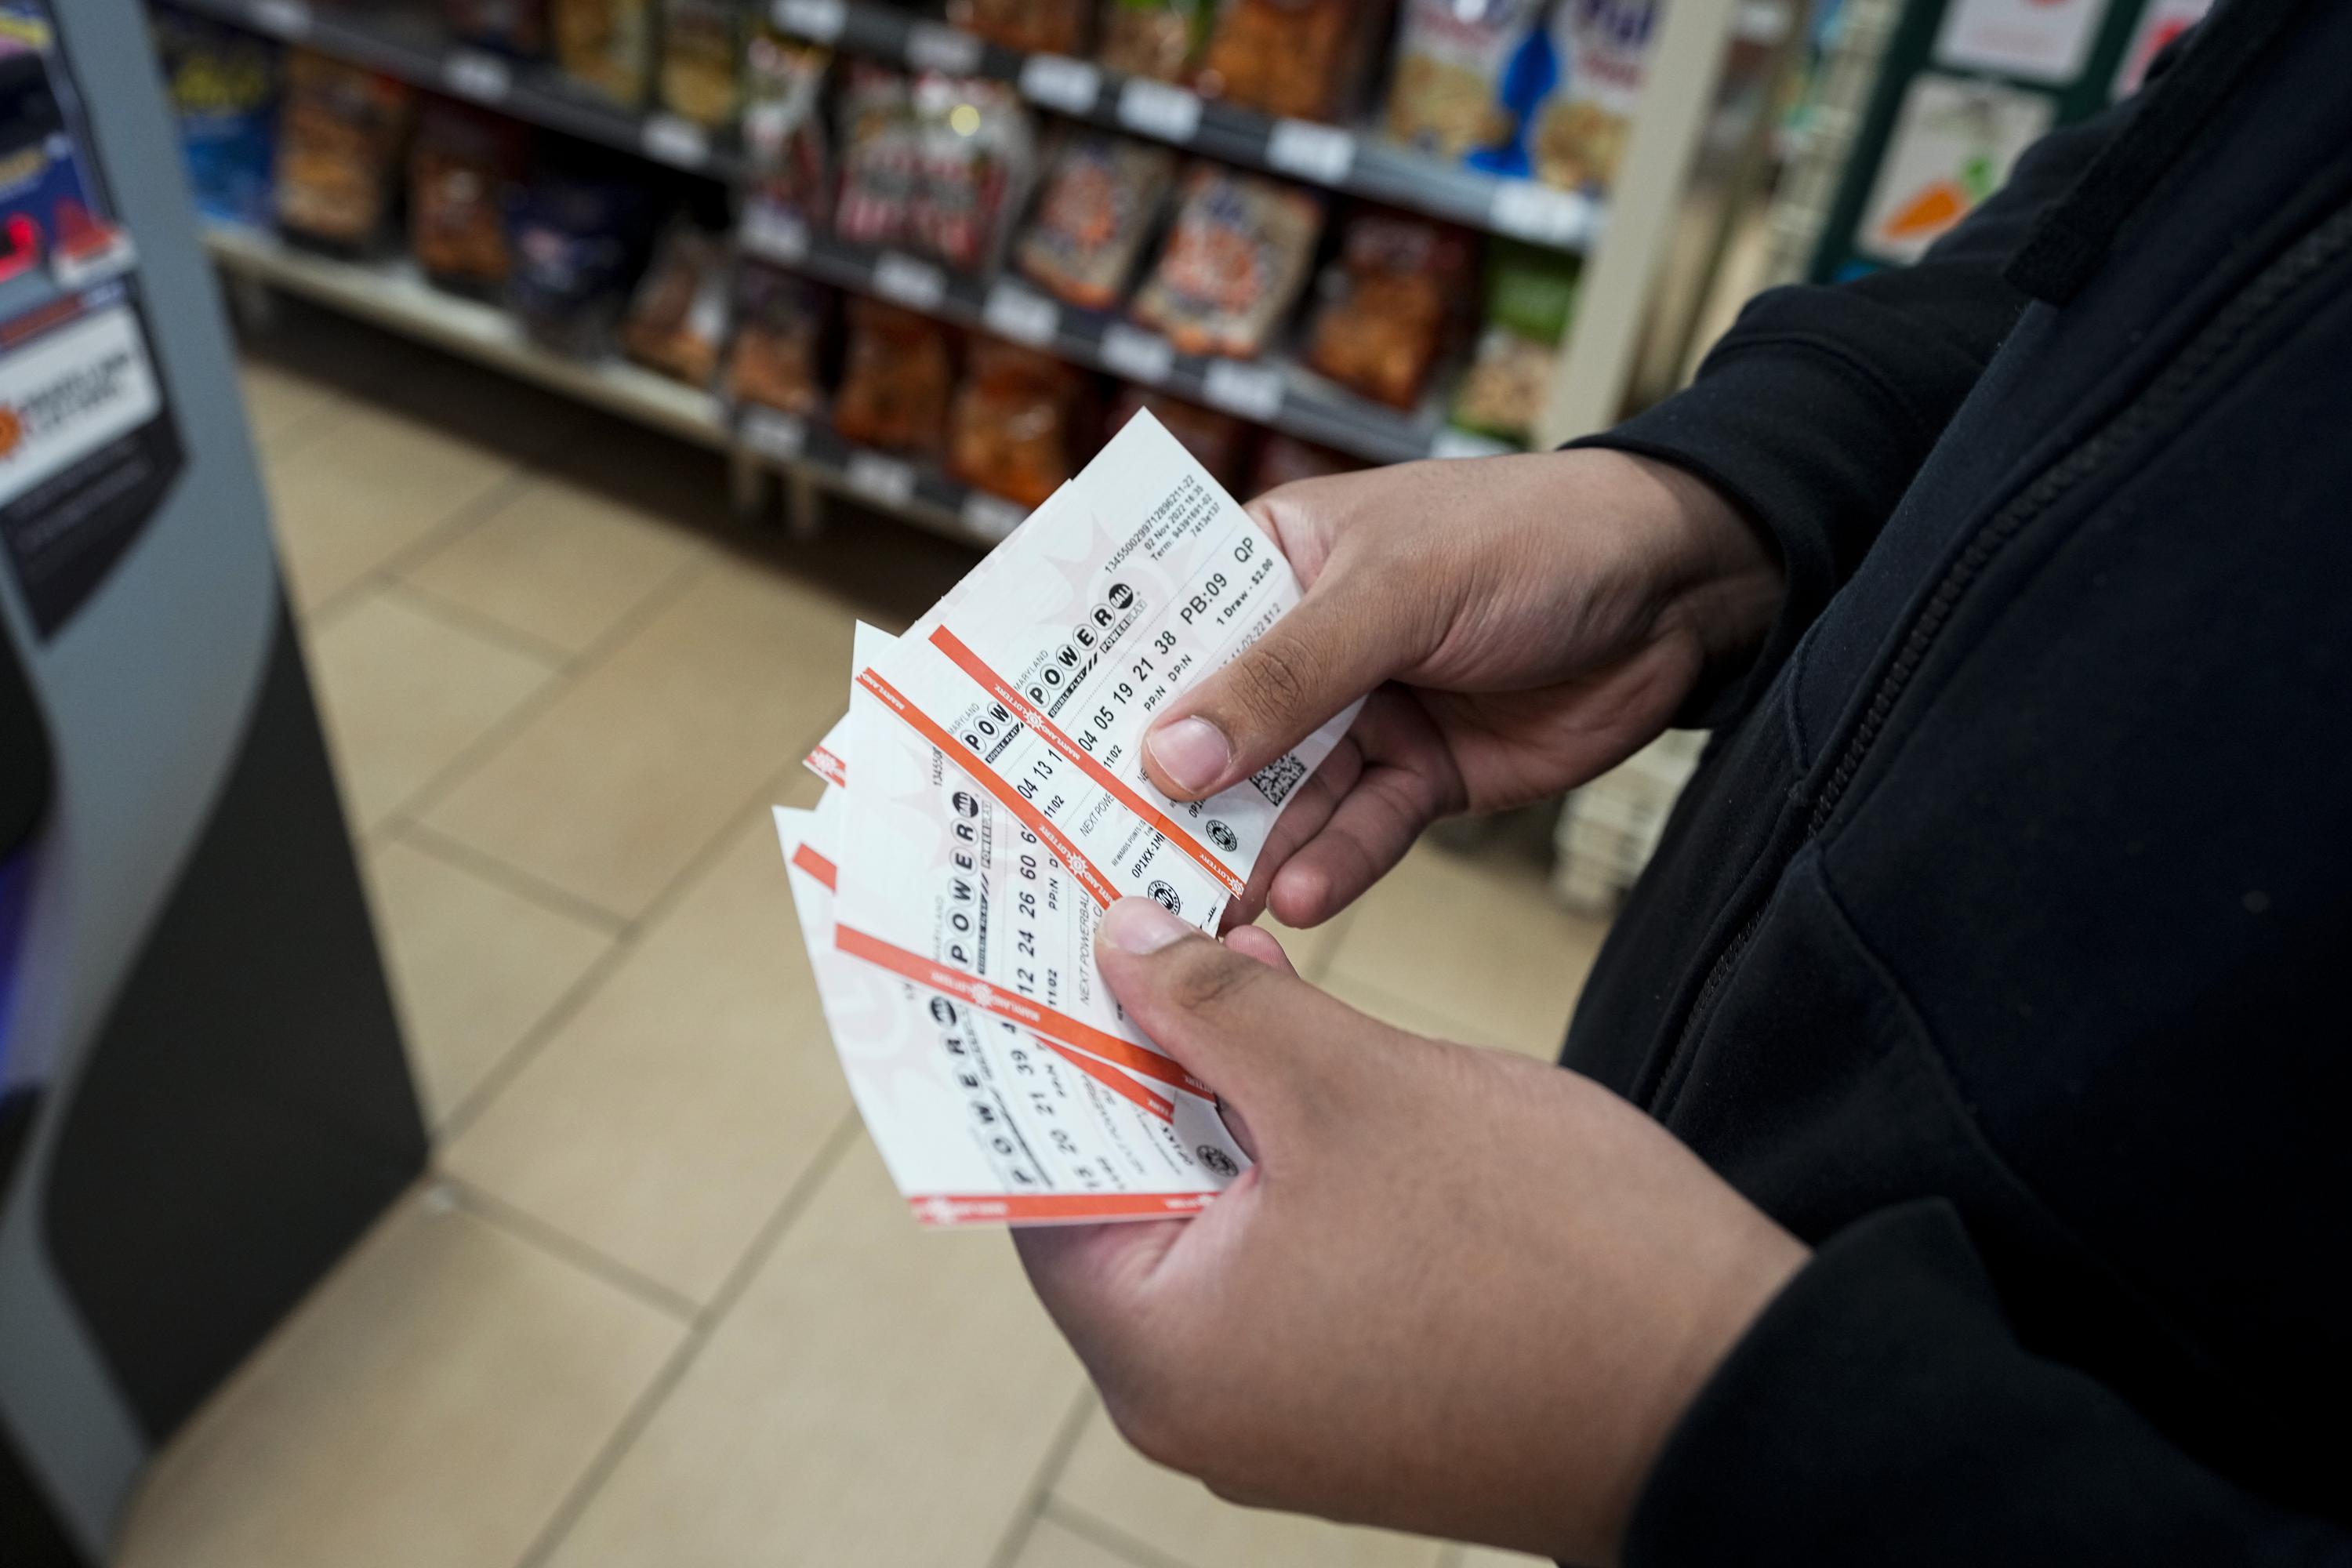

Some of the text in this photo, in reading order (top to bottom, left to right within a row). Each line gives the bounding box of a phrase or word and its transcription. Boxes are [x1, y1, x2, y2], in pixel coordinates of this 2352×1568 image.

[1144, 538, 1156, 550] 02
[1154, 523, 1171, 540] Nov
[1168, 504, 1186, 524] 2022
[1150, 538, 1174, 562] Term:
[1078, 536, 1254, 753] 04 05 19 21 38 PB:09 QP
[1103, 744, 1123, 768] 11/02
[1216, 616, 1225, 626] 1
[1223, 590, 1248, 618] Draw
[1251, 557, 1274, 585] $2.00
[1014, 650, 1048, 691] MARYLAND
[861, 673, 905, 710] MARYLAND
[947, 702, 980, 735] MARYLAND
[993, 684, 1081, 760] MARYLAND LOTTERY
[1017, 749, 1062, 799] 04 13 1
[1044, 795, 1064, 818] 11/02
[1080, 811, 1098, 837] NEXT
[1038, 825, 1114, 904] ARYLAND LOTTERY
[1112, 841, 1131, 866] REWARDS
[1128, 829, 1141, 848] POINTS
[1199, 853, 1234, 886] LOTTERY
[1017, 823, 1037, 995] 12 24 26 60 6
[1047, 969, 1058, 1007] 11/02
[1079, 967, 1091, 1007] NEXT
[1002, 1021, 1017, 1034] 4
[1011, 1050, 1034, 1076] 39
[1030, 1092, 1054, 1115] 21
[1051, 1129, 1076, 1154] 20
